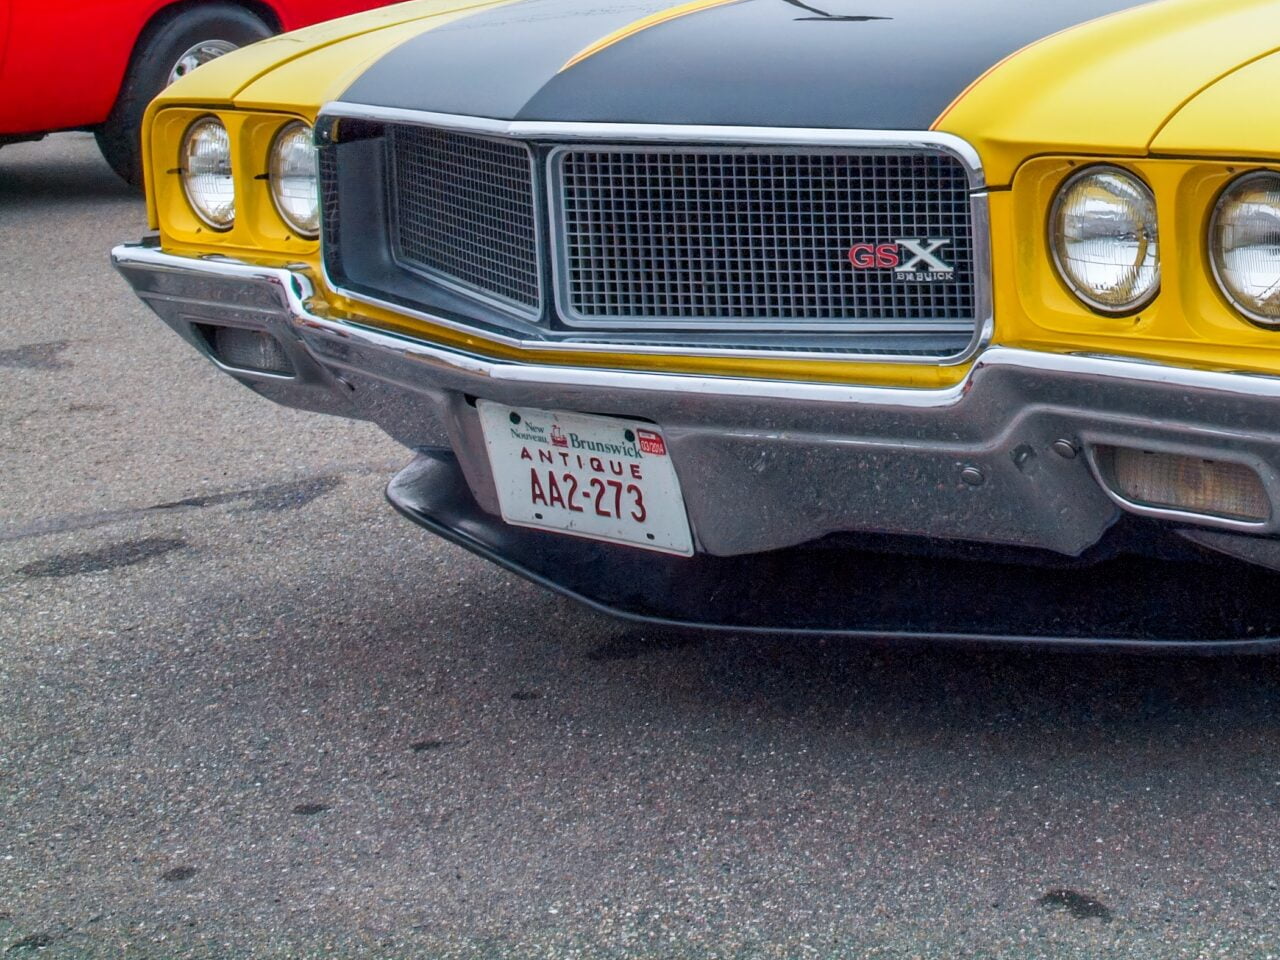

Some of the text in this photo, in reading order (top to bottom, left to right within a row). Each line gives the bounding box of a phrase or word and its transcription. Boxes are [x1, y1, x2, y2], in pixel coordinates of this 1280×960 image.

[848, 239, 954, 272] GSX
[510, 428, 547, 444] Nouveau
[524, 421, 545, 434] New
[568, 433, 643, 459] Brunswick
[520, 446, 643, 480] ANTIQUE
[530, 467, 647, 523] AA2-273
